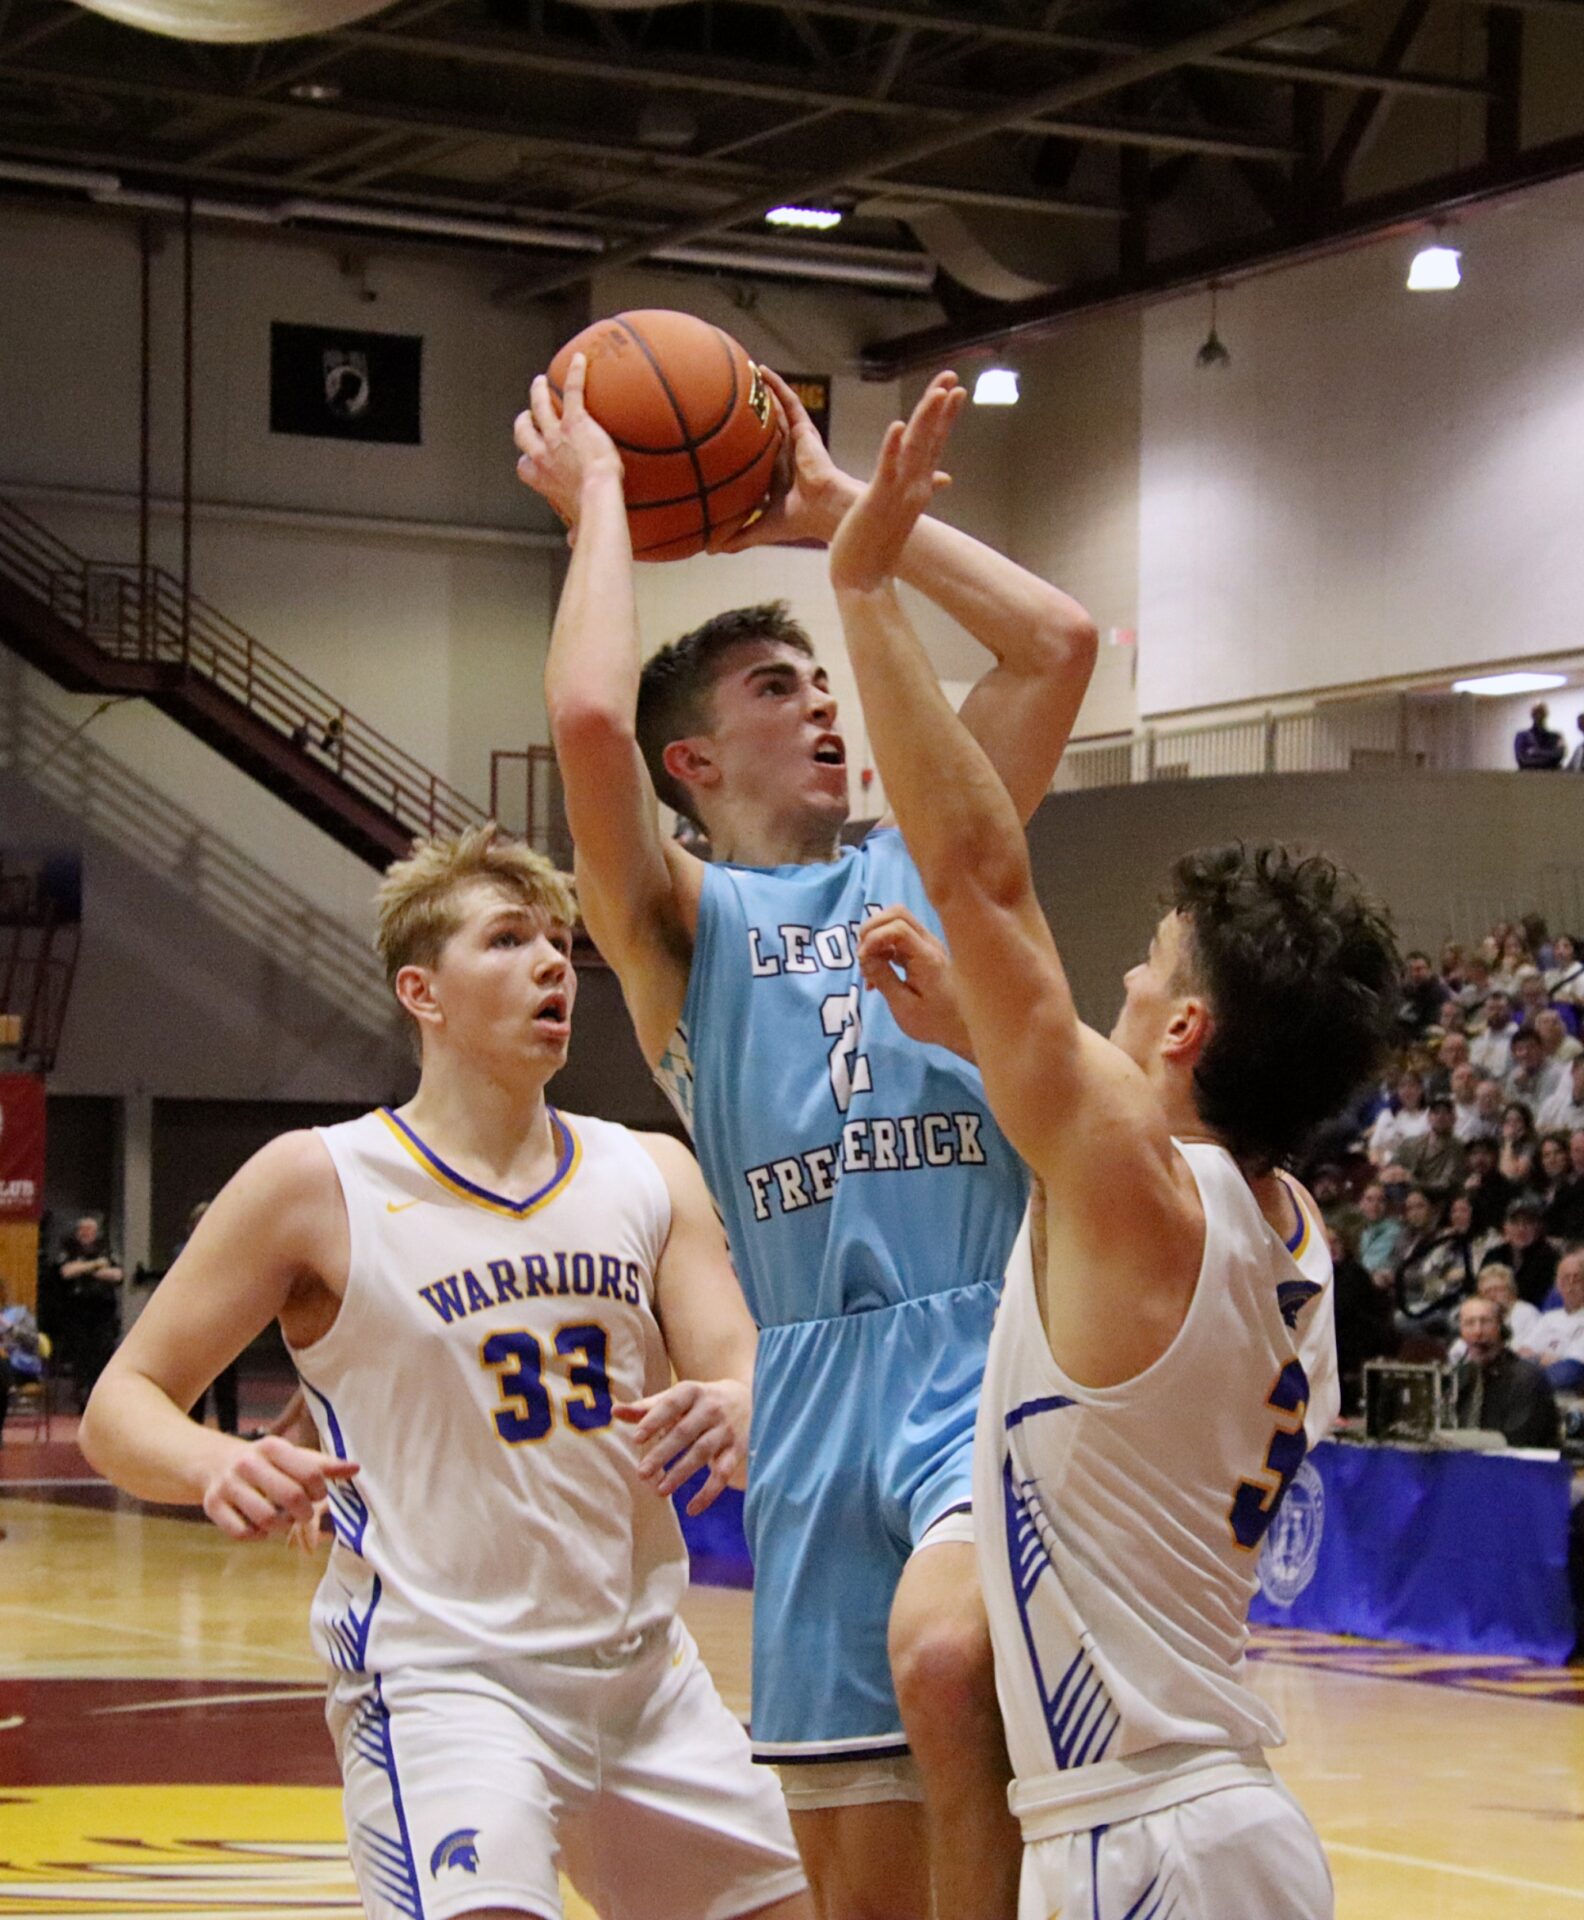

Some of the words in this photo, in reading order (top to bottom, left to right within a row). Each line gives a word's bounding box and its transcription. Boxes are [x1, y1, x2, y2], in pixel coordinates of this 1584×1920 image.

[819, 984, 873, 1114] 2
[744, 1111, 987, 1222] FREERICK
[418, 1252, 640, 1325] WARRIORS
[479, 1318, 614, 1447] 33
[1226, 1356, 1311, 1552] 3
